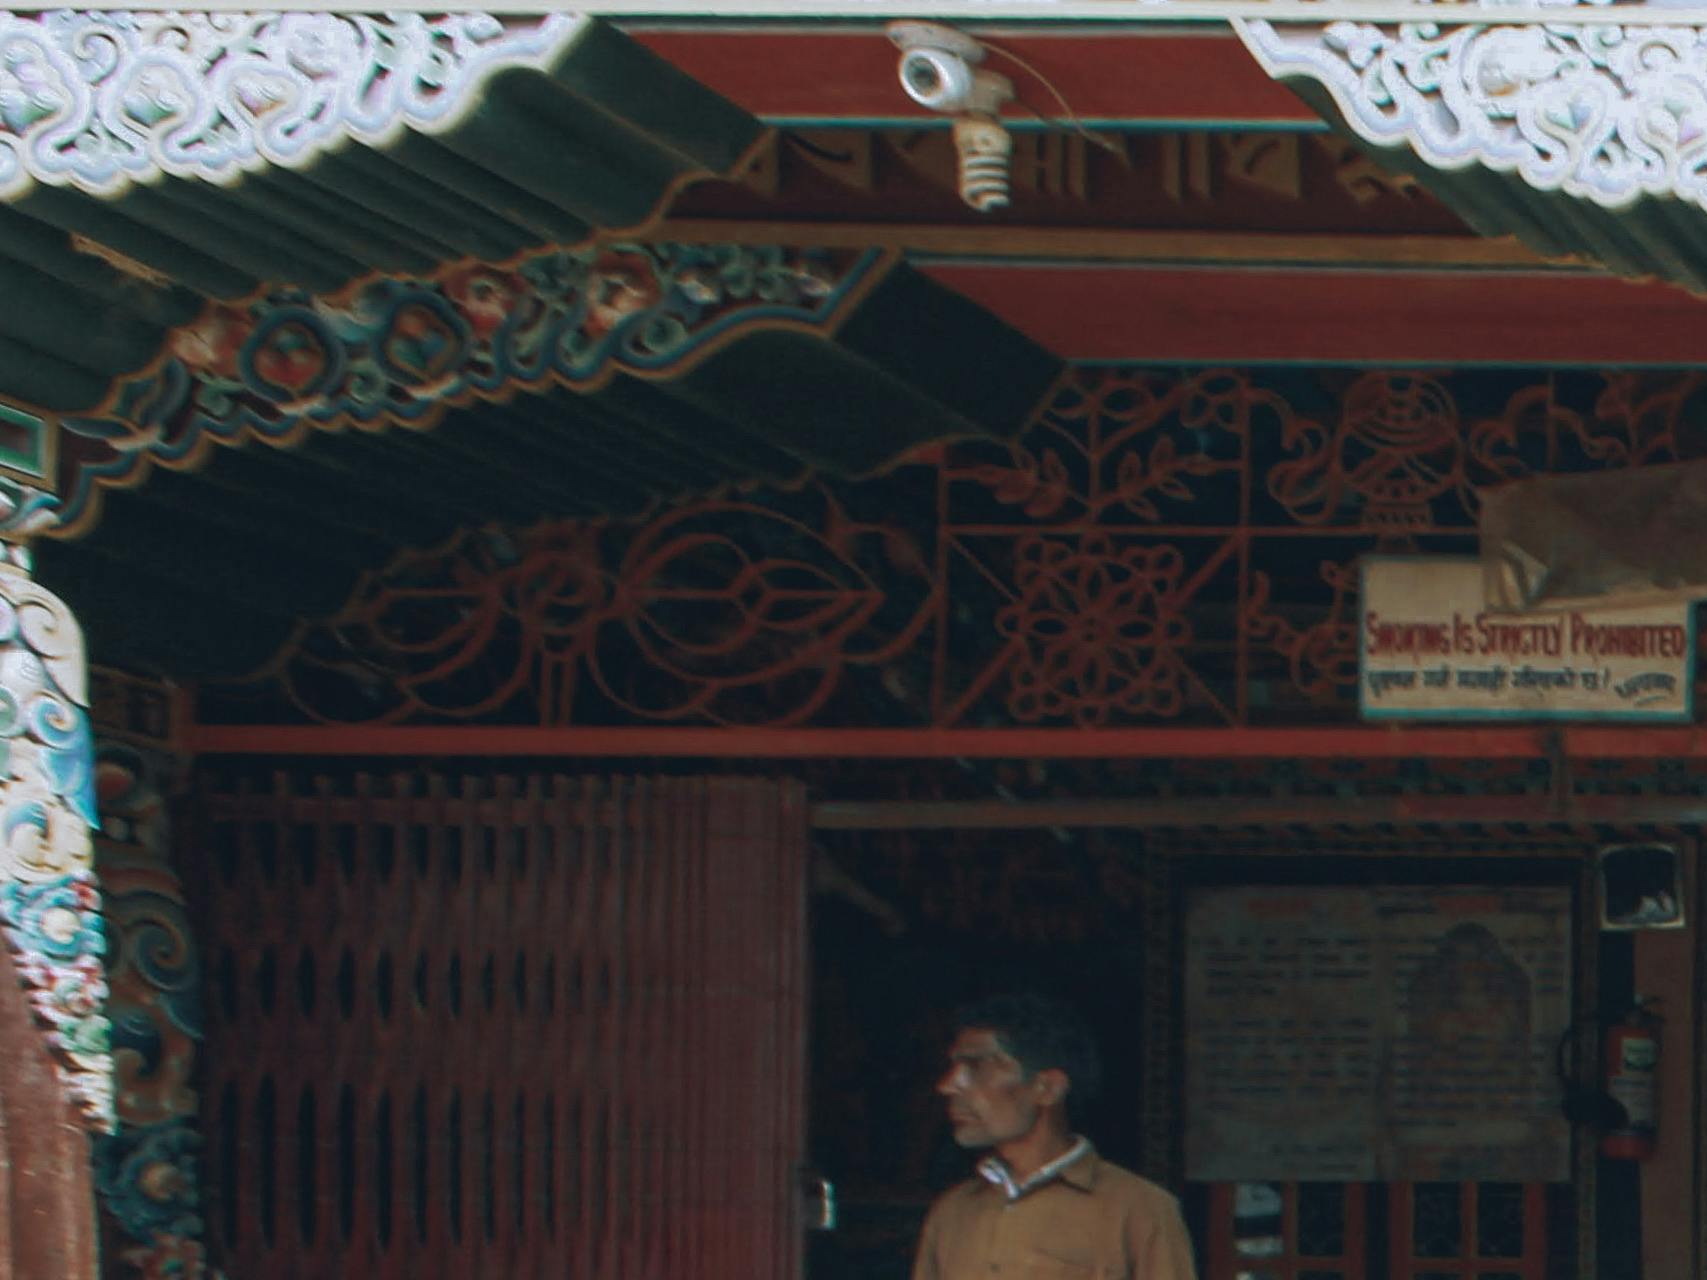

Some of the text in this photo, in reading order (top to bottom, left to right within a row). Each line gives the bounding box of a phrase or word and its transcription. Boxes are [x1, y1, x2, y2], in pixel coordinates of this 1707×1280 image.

[1366, 611, 1451, 655] SMOKING
[1475, 611, 1563, 656] STRICTLY
[1570, 612, 1685, 657] PROHIBITED
